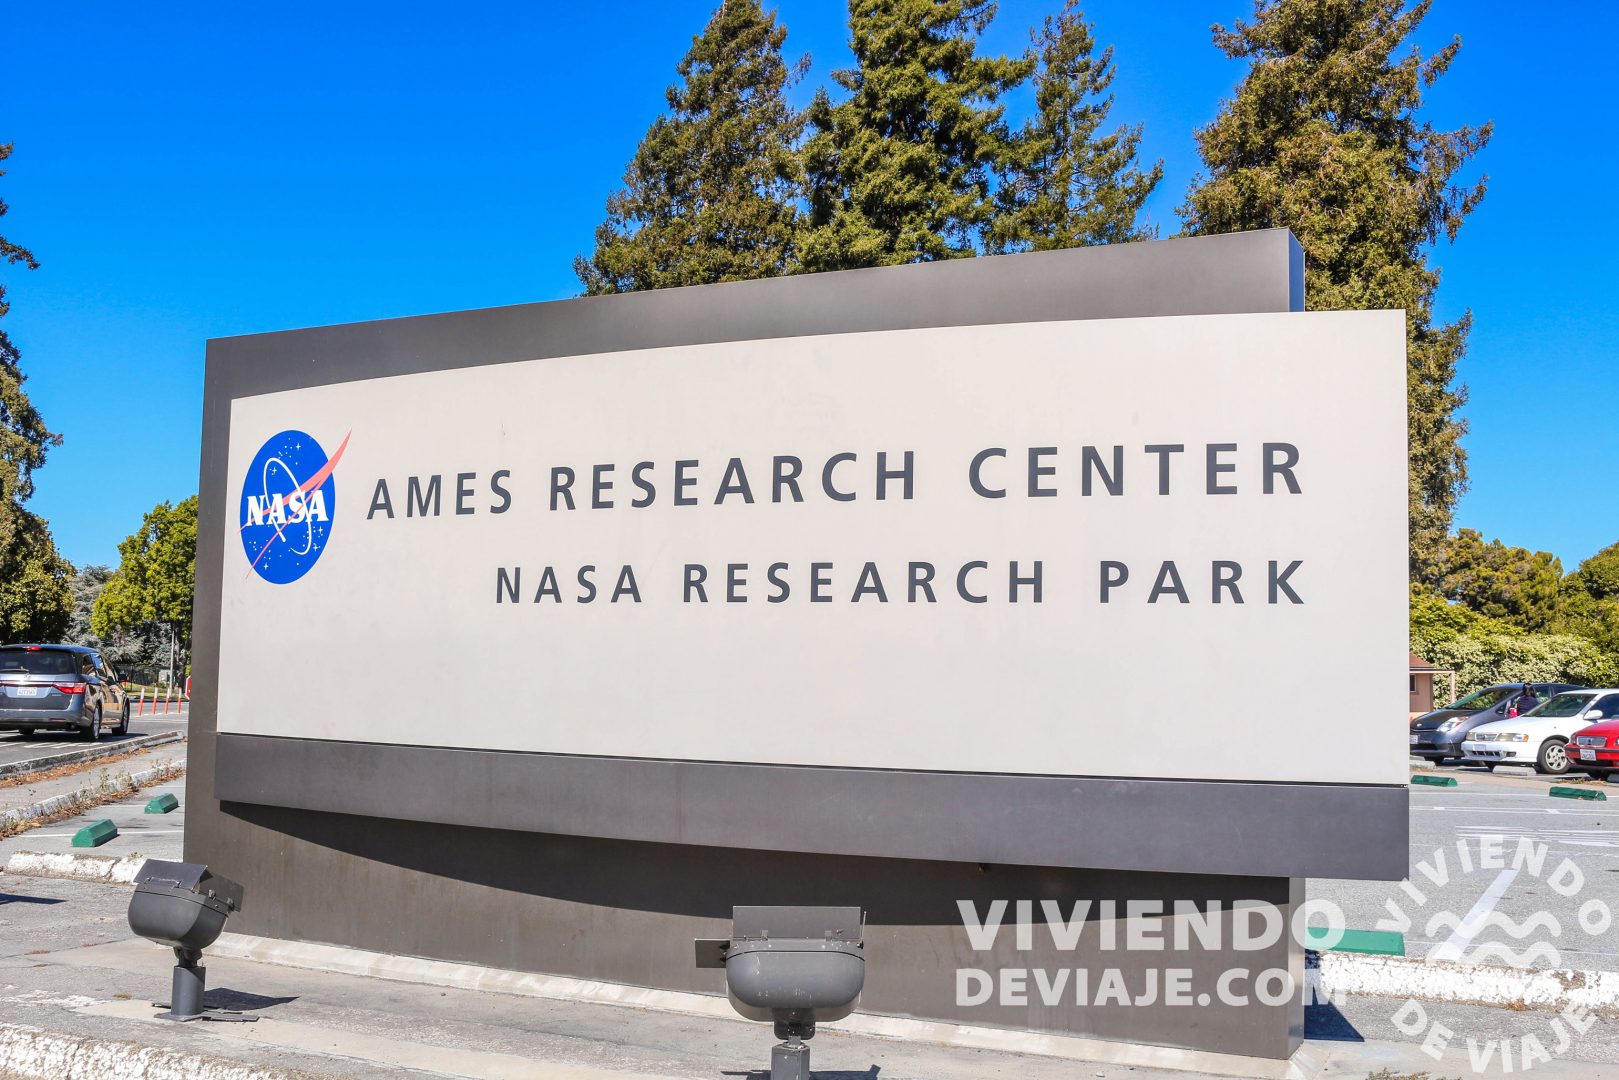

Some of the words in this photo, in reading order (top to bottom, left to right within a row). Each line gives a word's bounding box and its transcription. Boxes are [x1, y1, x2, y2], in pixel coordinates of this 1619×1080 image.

[367, 470, 512, 520] AMES
[549, 450, 914, 511] RESEARCH
[968, 442, 1302, 499] CENTER
[246, 489, 330, 527] NASA
[496, 564, 642, 604] NASA
[683, 560, 1043, 604] RESEARCH
[1099, 560, 1305, 605] PARK
